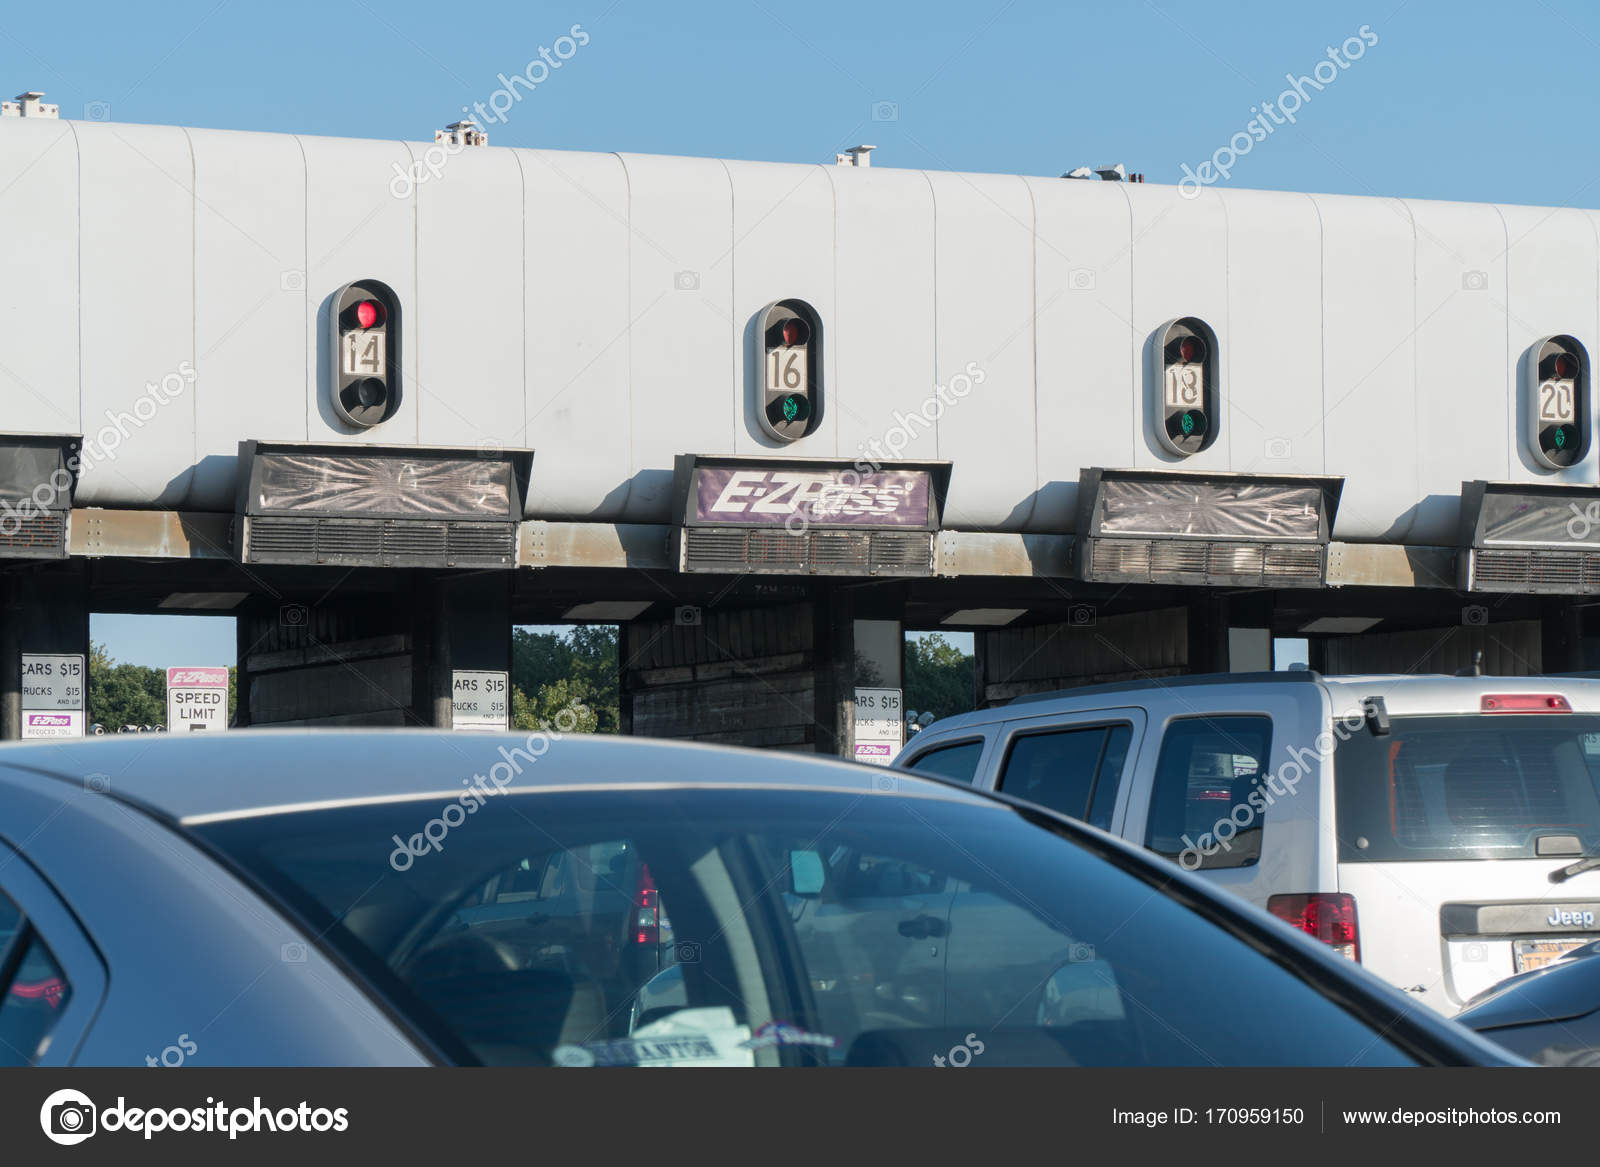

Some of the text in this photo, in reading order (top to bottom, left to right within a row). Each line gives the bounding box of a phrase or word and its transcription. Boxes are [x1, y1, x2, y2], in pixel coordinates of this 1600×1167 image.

[349, 334, 379, 372] 14
[772, 351, 800, 388] 16
[1170, 369, 1197, 404] 18
[1542, 384, 1570, 418] 20
[21, 662, 80, 677] CARS $15
[23, 686, 80, 696] RUCKS $15
[454, 678, 505, 692] ARS $15
[175, 693, 221, 704] SPEED
[854, 695, 899, 709] ARS $15
[452, 702, 505, 711] RUCKS $15
[180, 708, 216, 720] LIMIT
[855, 718, 899, 727] UCKS $15
[1547, 906, 1594, 928] Jeep
